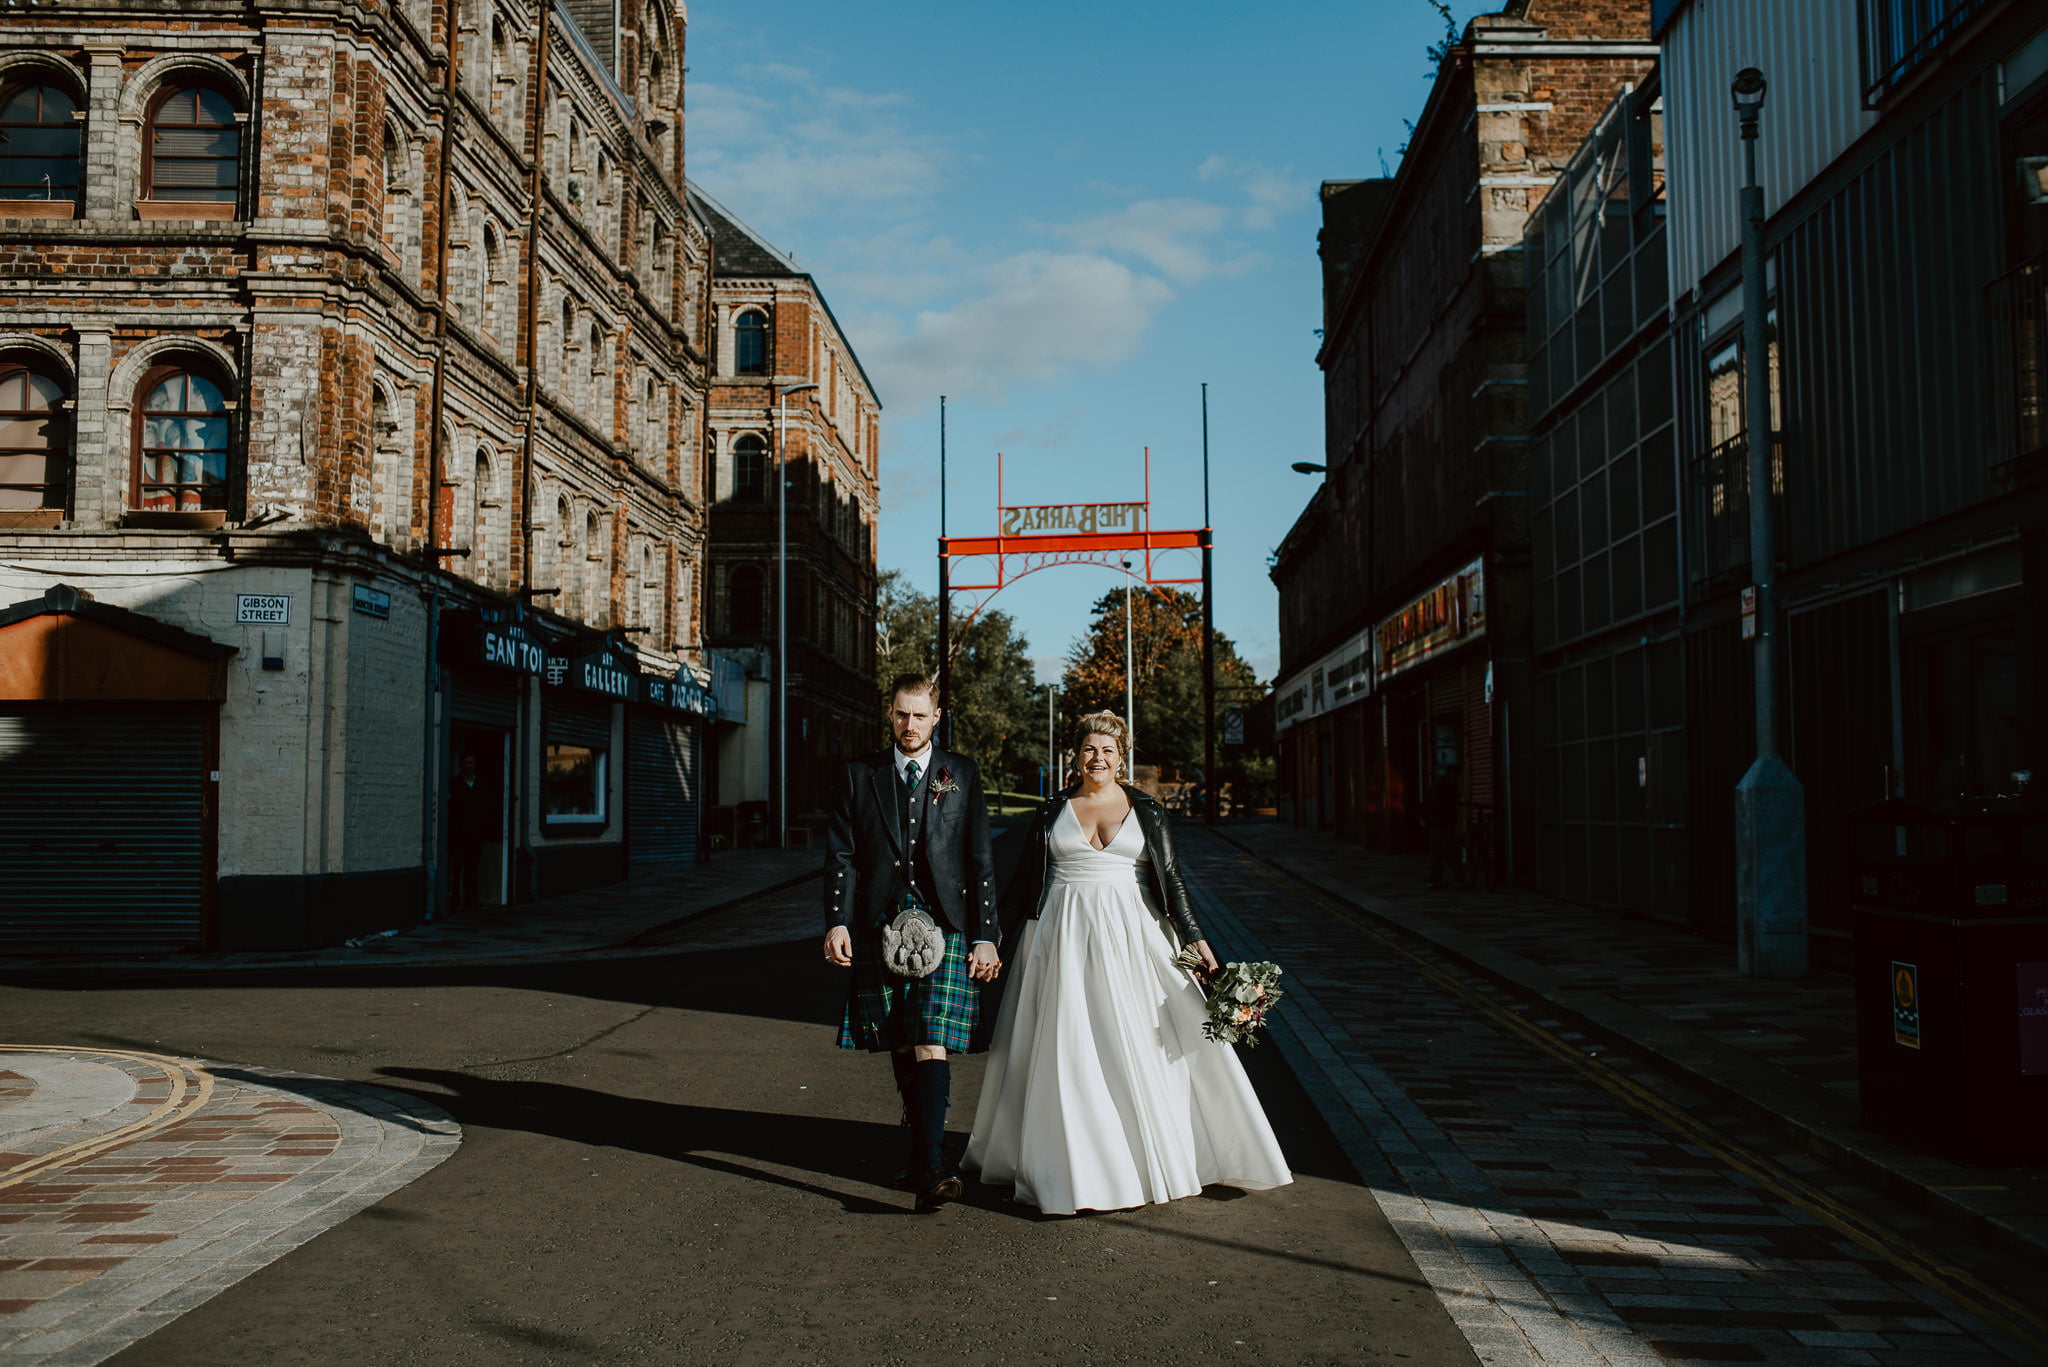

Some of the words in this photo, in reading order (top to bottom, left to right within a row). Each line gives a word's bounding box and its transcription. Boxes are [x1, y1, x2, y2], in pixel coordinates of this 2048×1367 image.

[242, 598, 284, 609] GIBSON
[241, 609, 284, 621] STREET
[485, 632, 516, 668] SAN
[519, 641, 543, 673] TOI
[584, 663, 630, 697] GALLERY
[649, 681, 665, 702] CAFE
[2023, 879, 2048, 889] LITT
[2022, 1006, 2048, 1017] GLAS
